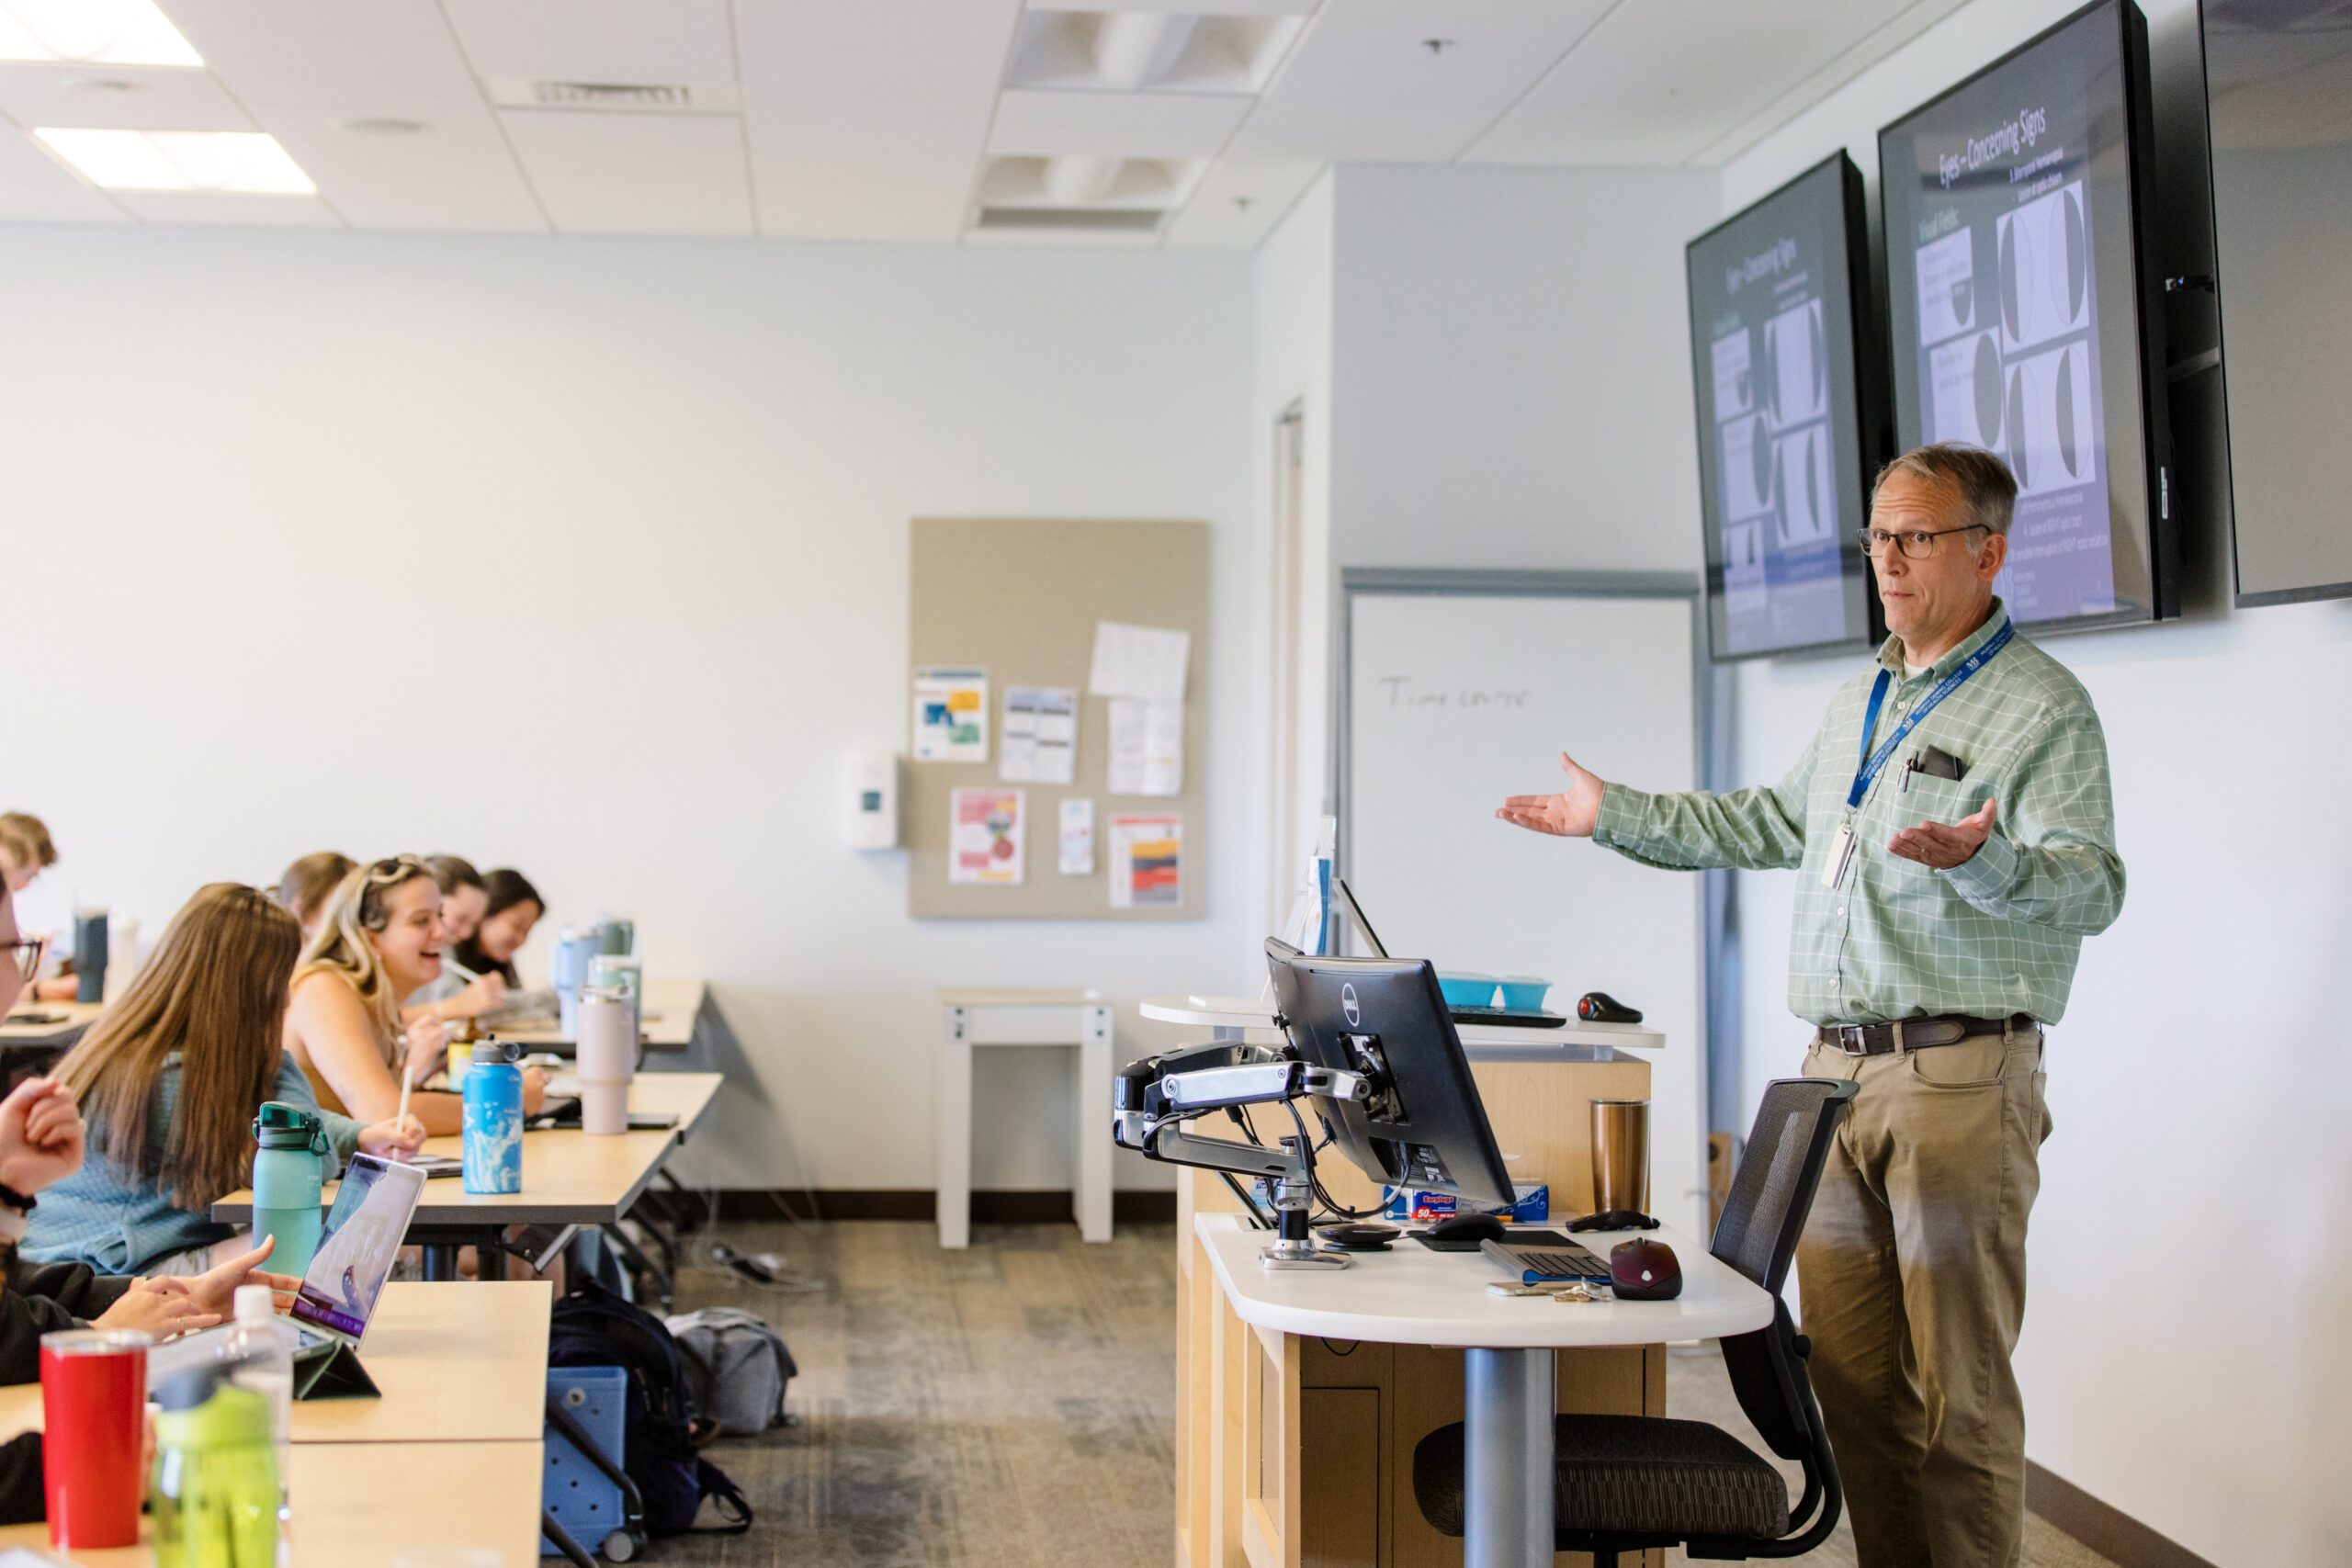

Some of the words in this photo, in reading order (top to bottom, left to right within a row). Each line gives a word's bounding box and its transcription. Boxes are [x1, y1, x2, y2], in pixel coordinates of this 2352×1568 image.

[1939, 153, 1960, 190] Eyes
[1967, 120, 2019, 170] Concerning
[2020, 107, 2046, 147] Signs
[1944, 669, 1963, 686] COLLEGE
[1926, 693, 1943, 709] HEALTH
[1940, 676, 1962, 695] SCIENCES
[1344, 998, 1357, 1010] DELL
[1418, 1209, 1430, 1218] 50
